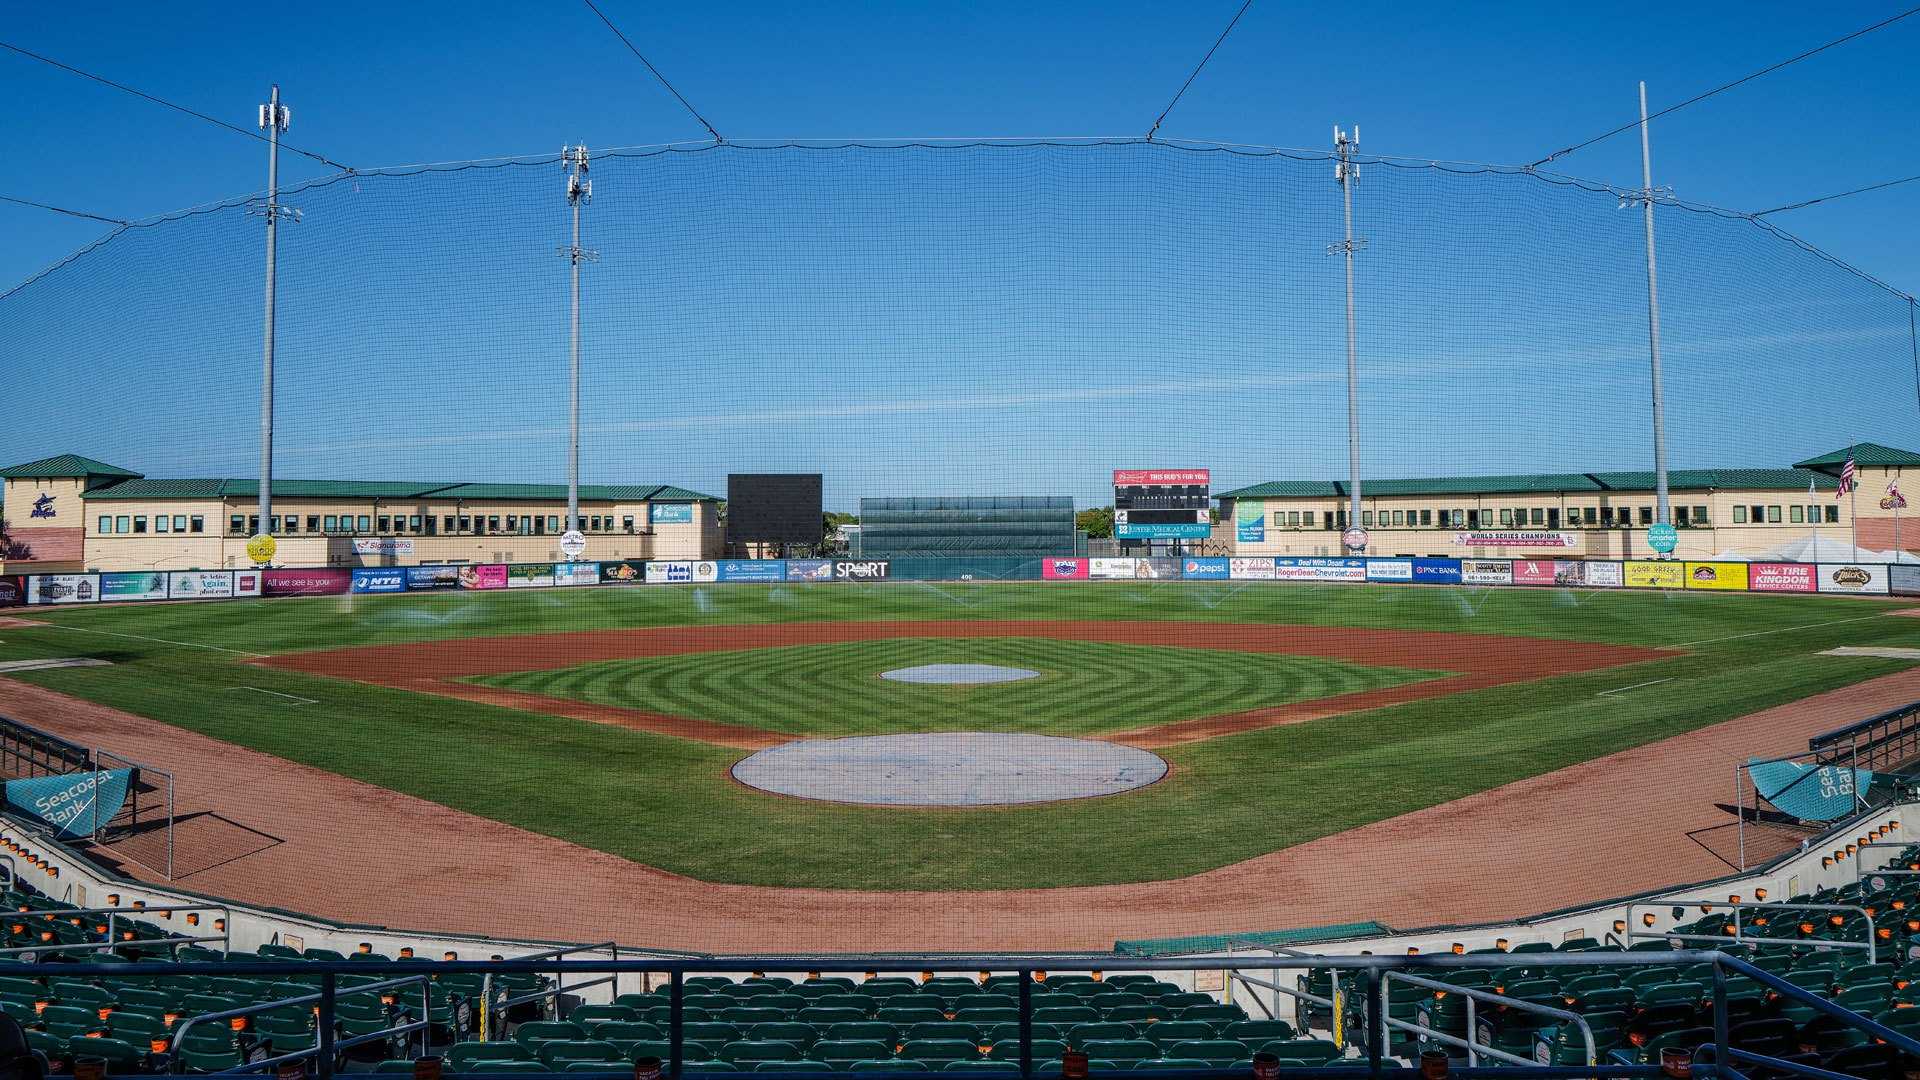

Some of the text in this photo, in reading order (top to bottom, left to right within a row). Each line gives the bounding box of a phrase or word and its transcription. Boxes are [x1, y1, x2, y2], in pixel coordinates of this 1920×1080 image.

[1200, 564, 1224, 572] pepsi
[1782, 567, 1808, 575] TIRE
[1278, 568, 1365, 578] RogerDeanChevrolet.com
[267, 579, 277, 587] All
[315, 579, 330, 588] you
[371, 577, 401, 585] NTB
[1755, 575, 1810, 584] KINGDOM
[36, 770, 113, 814] Seacoast
[44, 799, 85, 824] Bank
